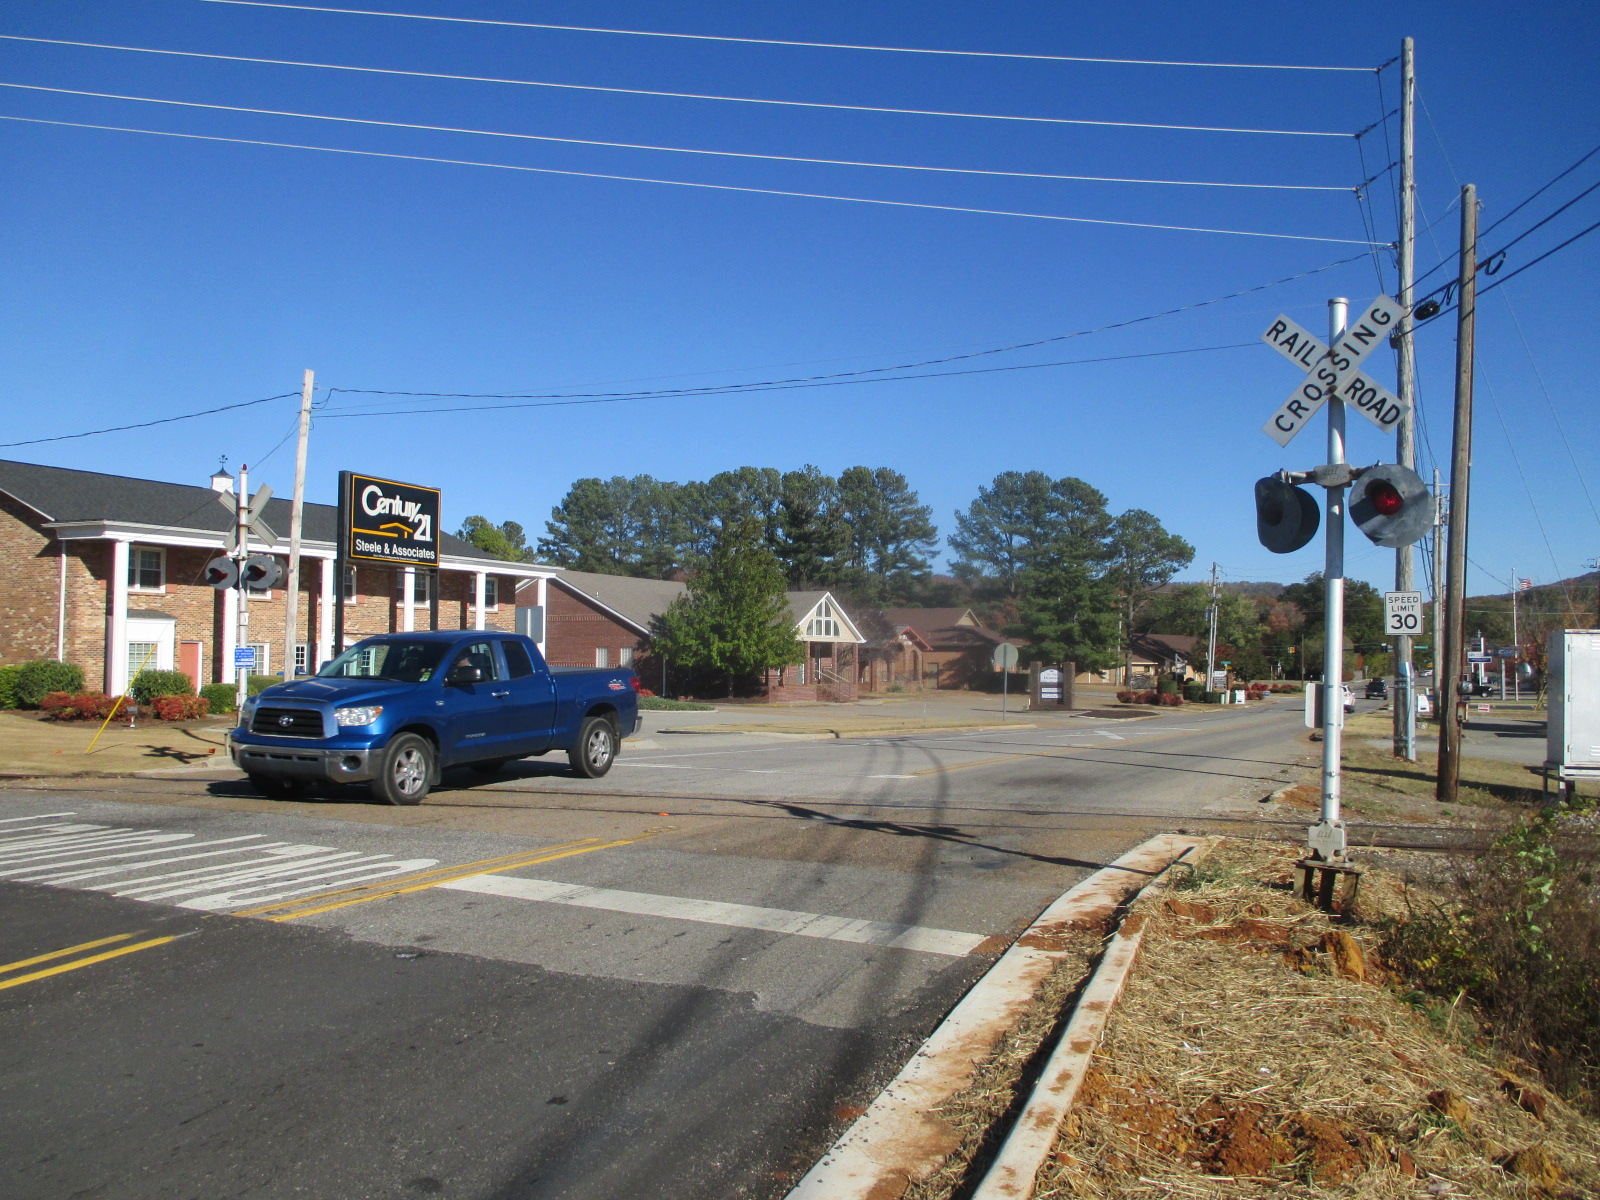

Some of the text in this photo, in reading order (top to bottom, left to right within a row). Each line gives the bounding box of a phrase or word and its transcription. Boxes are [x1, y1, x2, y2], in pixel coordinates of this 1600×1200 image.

[1266, 320, 1401, 425] RAIL ROAD
[1275, 308, 1391, 432] CROSSING
[362, 484, 431, 542] Century 21
[355, 538, 382, 554] Steele
[383, 542, 391, 554] &
[392, 543, 435, 560] Associates
[1388, 596, 1419, 604] SPEED
[1390, 614, 1418, 630] 30
